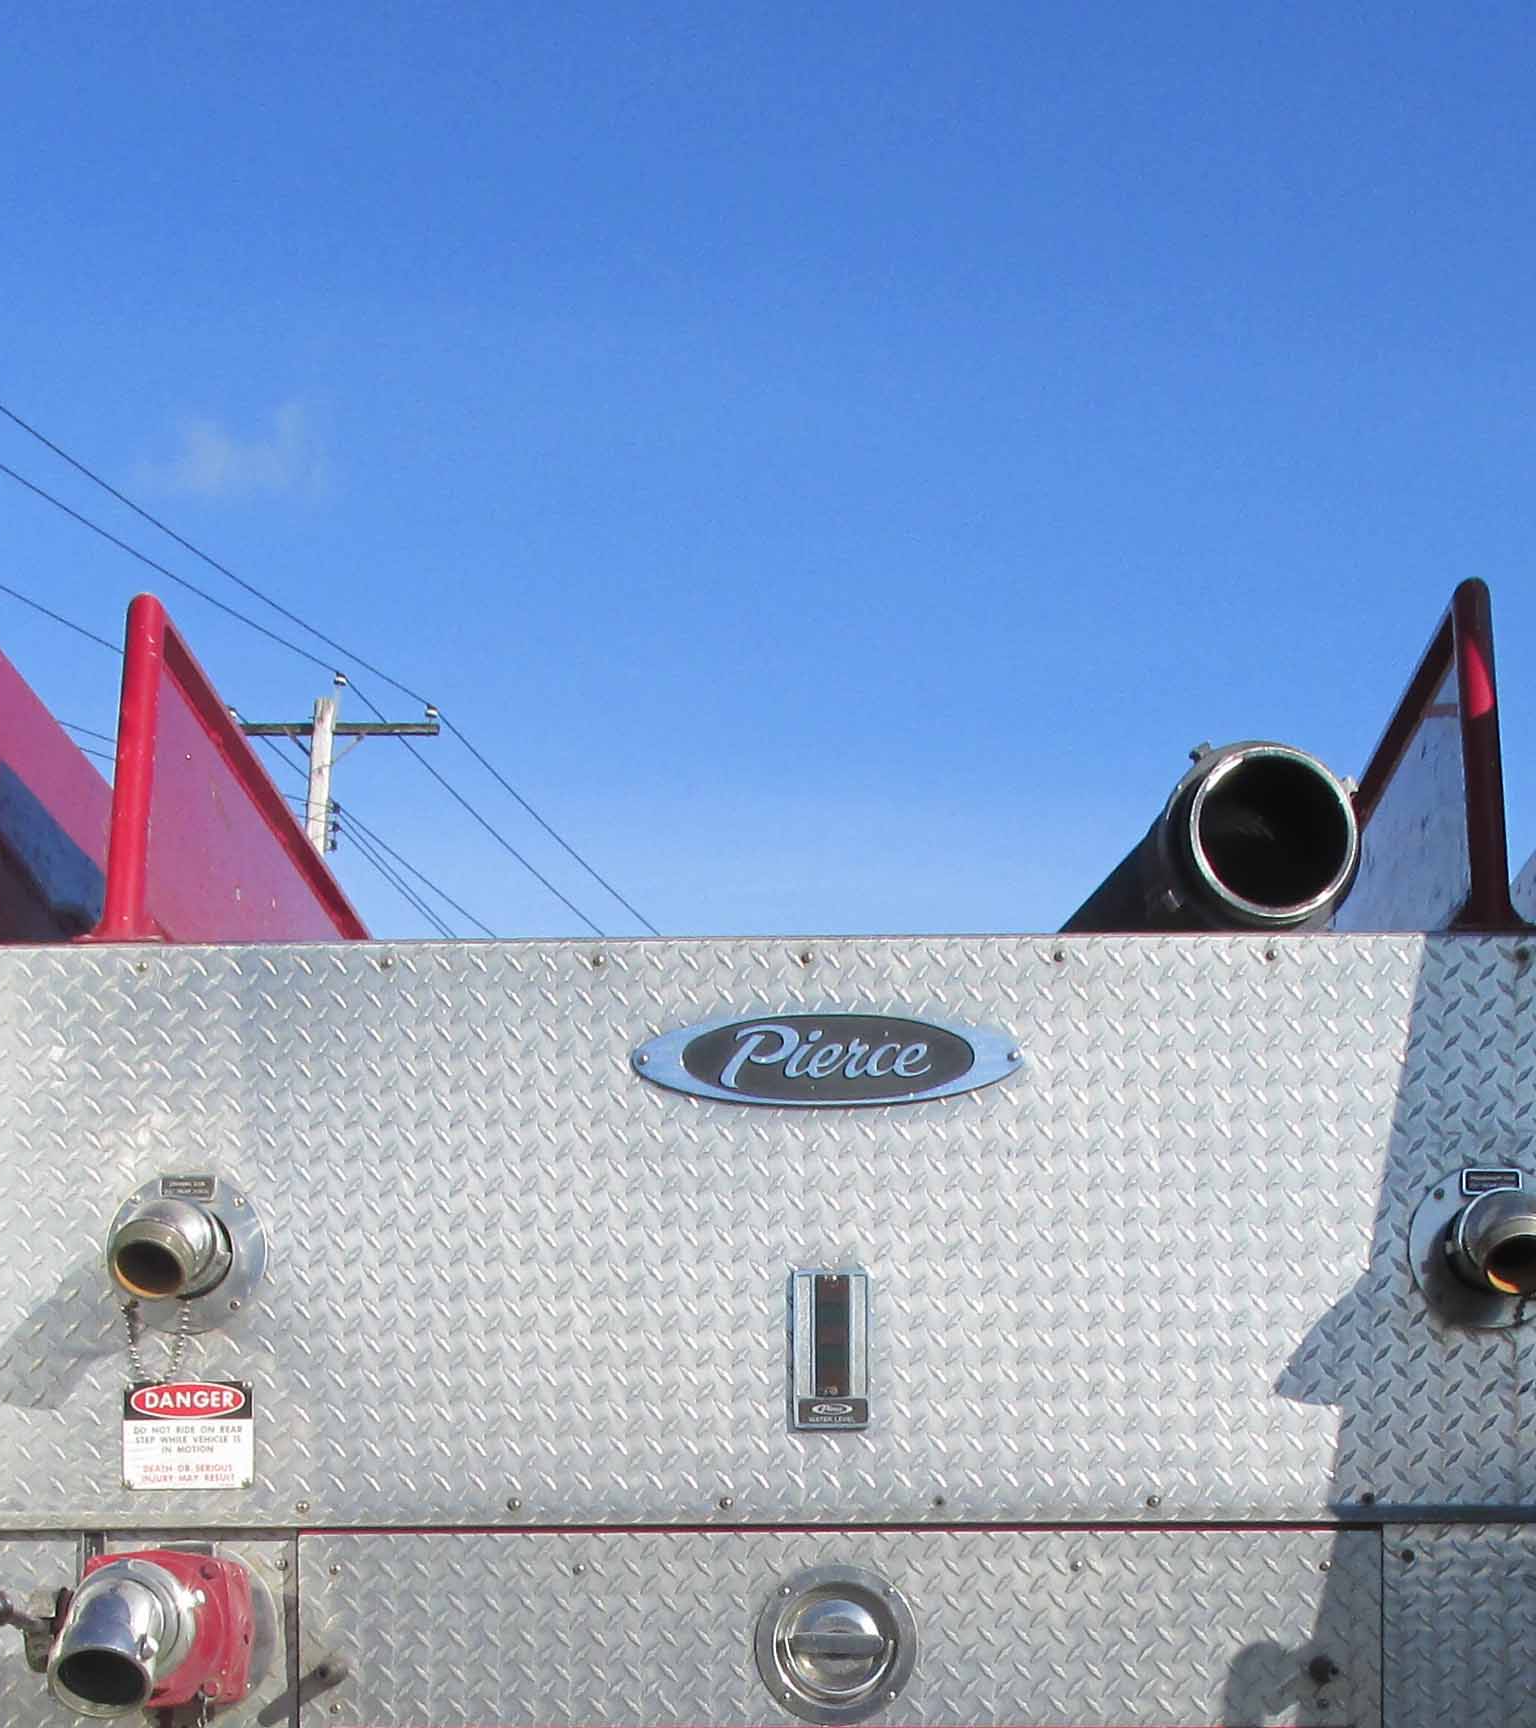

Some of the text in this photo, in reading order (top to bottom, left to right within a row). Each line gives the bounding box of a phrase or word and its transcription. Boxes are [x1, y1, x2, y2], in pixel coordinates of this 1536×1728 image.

[718, 1023, 932, 1089] Pierce
[144, 1391, 234, 1409] DANGER
[133, 1425, 243, 1435] DO NOT RIDE ON REAR
[135, 1434, 242, 1445] STEP WHILE VEHICLE IS
[161, 1445, 214, 1454] IN MOTION
[143, 1463, 233, 1473] DEATH OR SERIOUS
[142, 1473, 235, 1483] INJURY MAY RESULT
